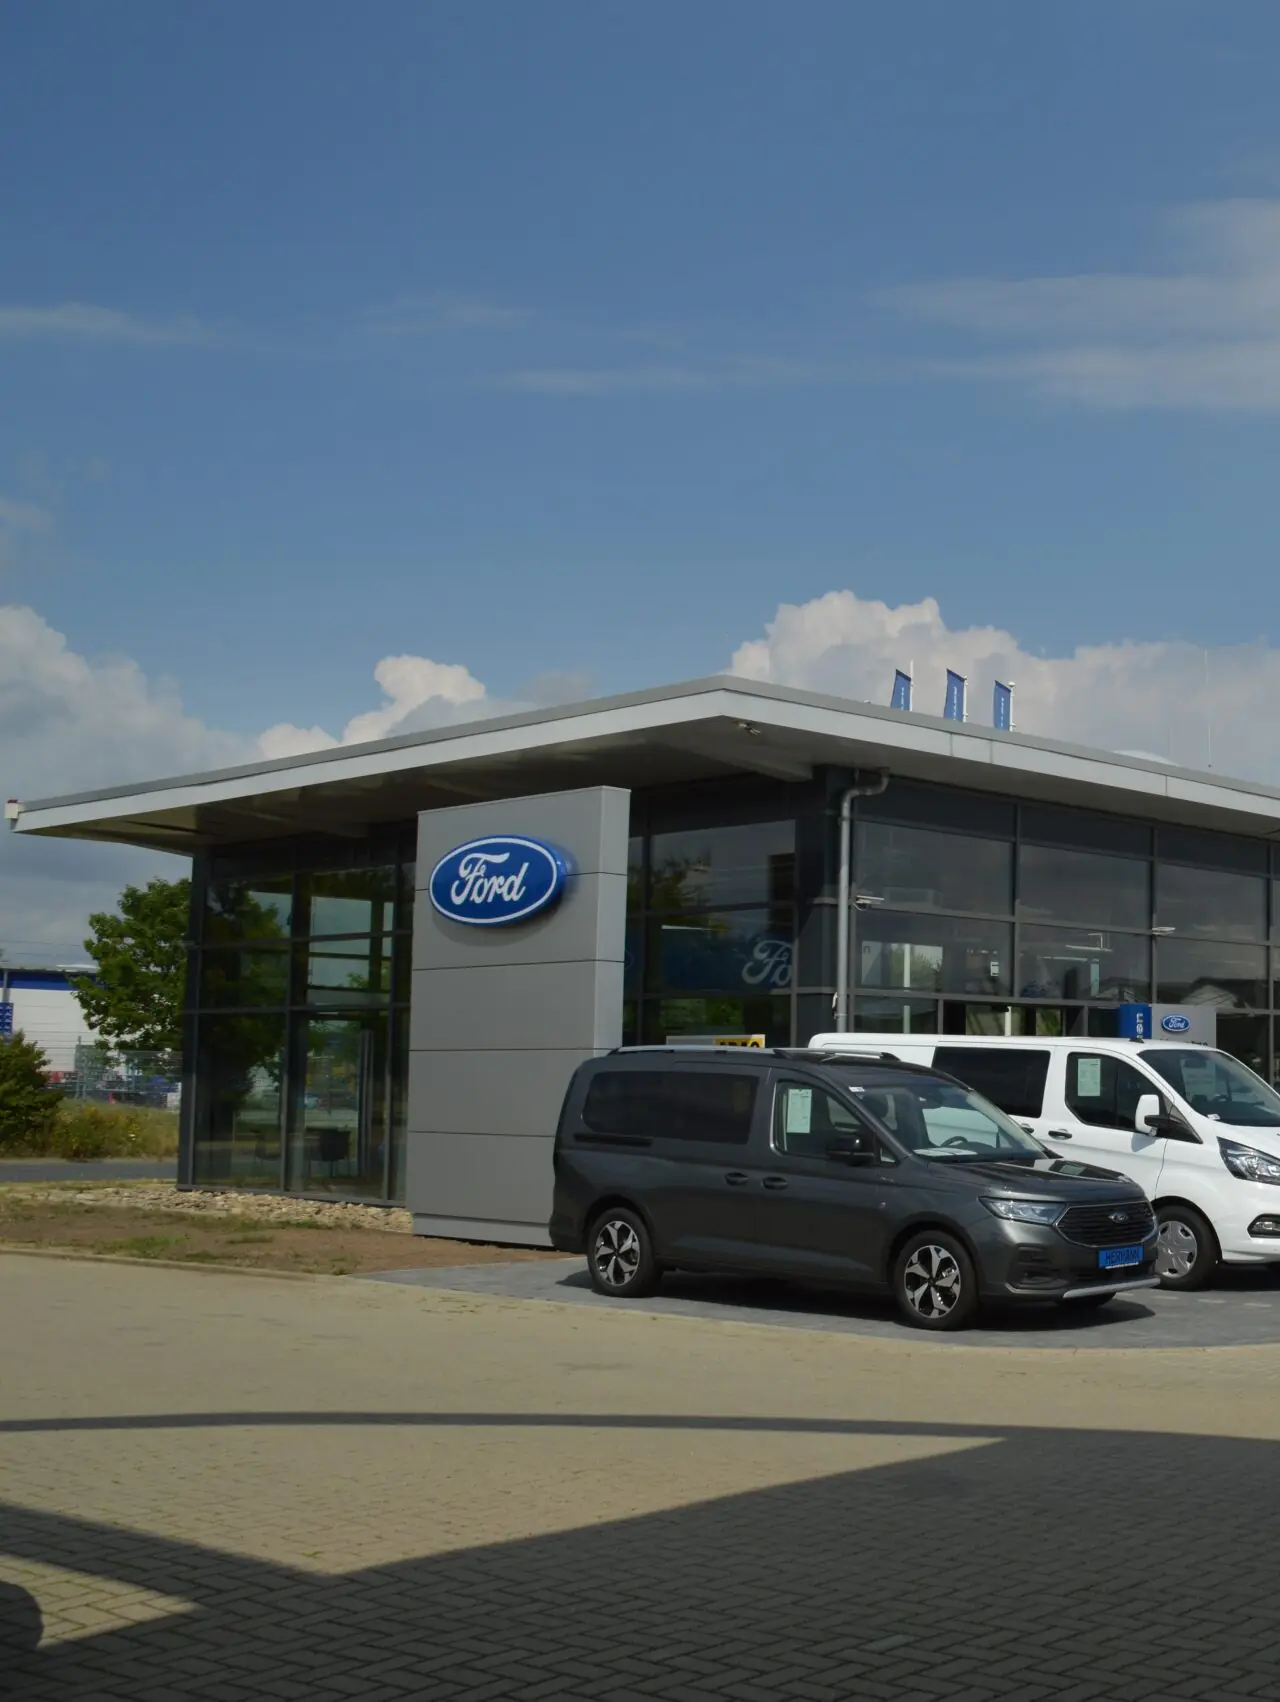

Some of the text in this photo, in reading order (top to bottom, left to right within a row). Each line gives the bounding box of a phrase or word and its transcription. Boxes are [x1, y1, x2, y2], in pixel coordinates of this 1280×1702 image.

[450, 852, 529, 905] Ford
[741, 940, 792, 986] Fo
[1168, 1017, 1186, 1029] Ford
